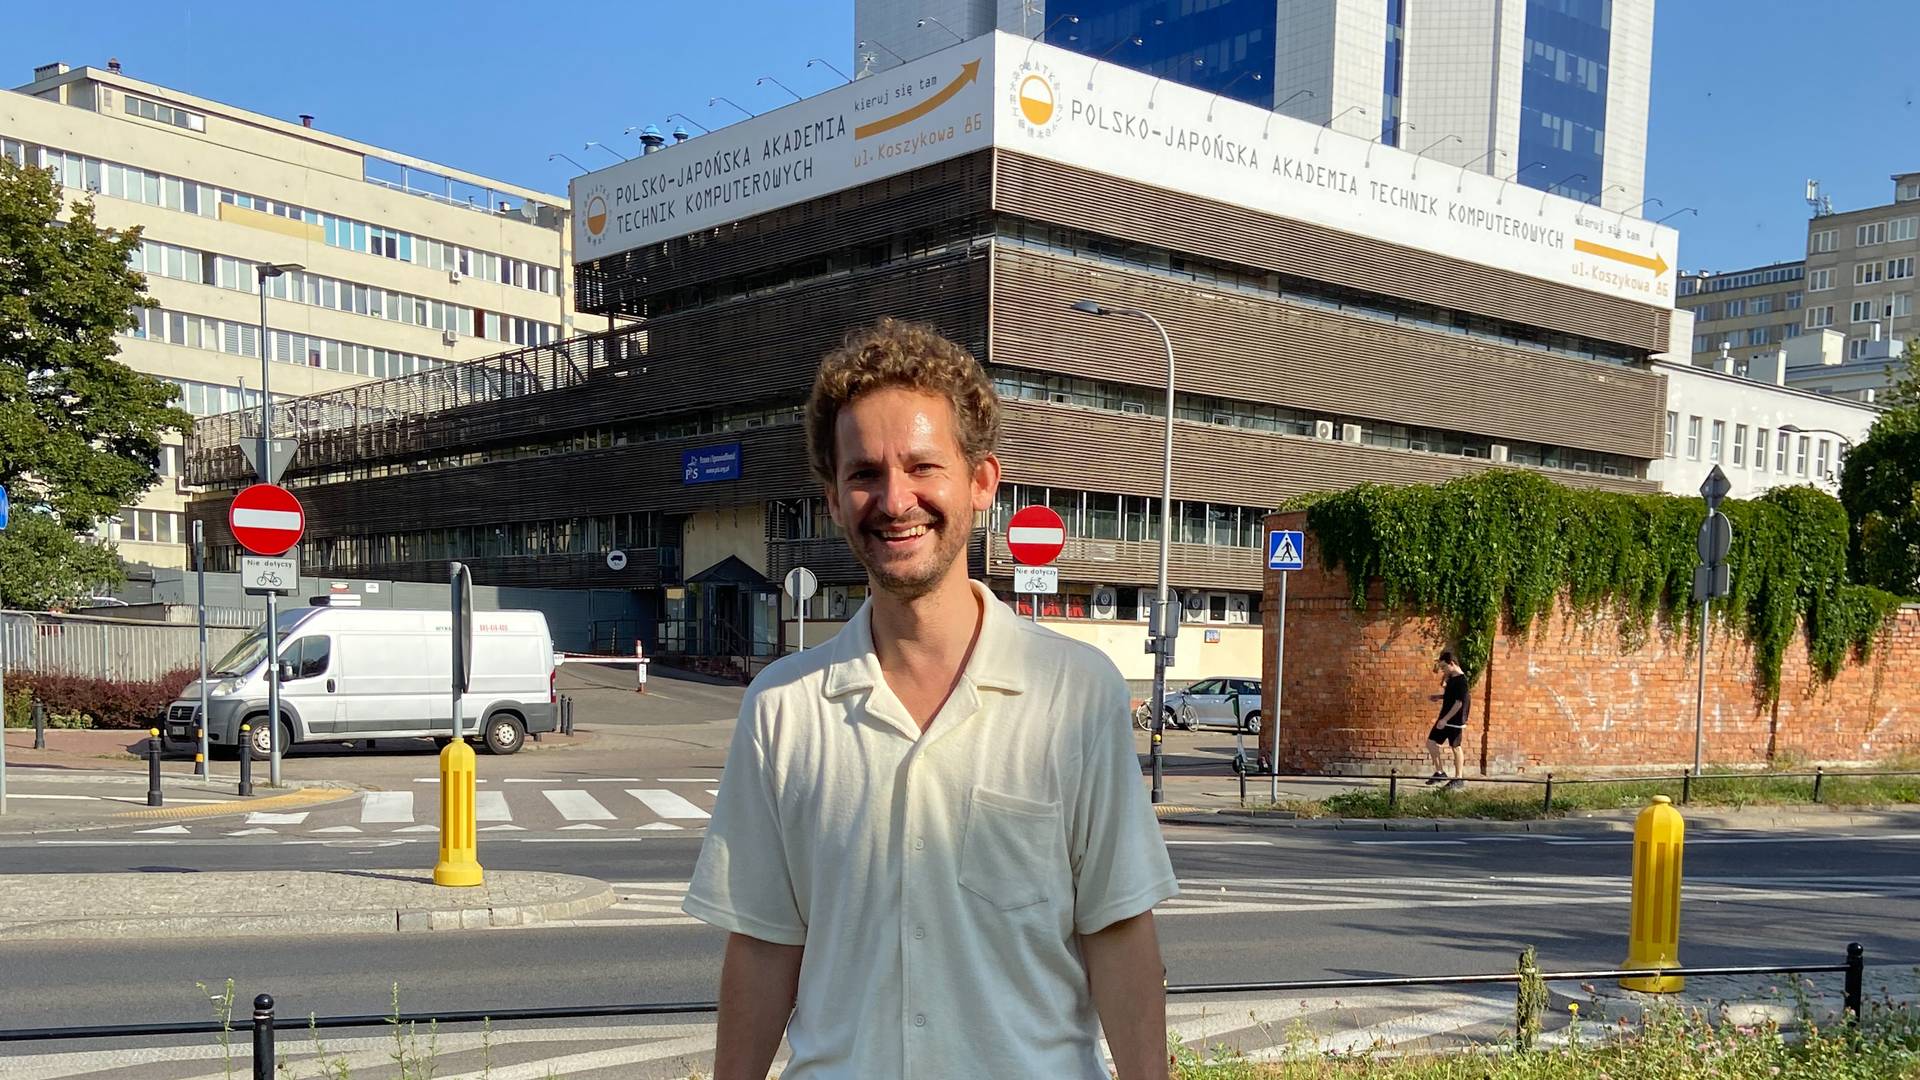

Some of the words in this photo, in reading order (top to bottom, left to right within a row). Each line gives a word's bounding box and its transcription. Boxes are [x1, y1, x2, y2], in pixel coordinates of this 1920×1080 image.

[854, 90, 889, 112] kieruj
[895, 83, 913, 98] się
[919, 75, 937, 91] tam
[878, 126, 954, 161] Koszykowa
[964, 113, 982, 133] 86
[616, 148, 752, 206] POLSKO-JAPOŃSKA
[763, 114, 846, 160] AKADEMIA
[1072, 100, 1258, 169] POLSKO-JAPOŃSKA
[1272, 155, 1357, 195] AKADEMIA
[1370, 181, 1437, 216] TECHNIK
[1449, 202, 1564, 249] KOMPUTEROWYCH
[617, 199, 675, 233] TECHNIK
[686, 157, 813, 214] KOMPUTEROWYCH
[1592, 265, 1650, 291] Koszykowa
[264, 560, 292, 568] dotyczy
[1031, 568, 1056, 576] dotyczy
